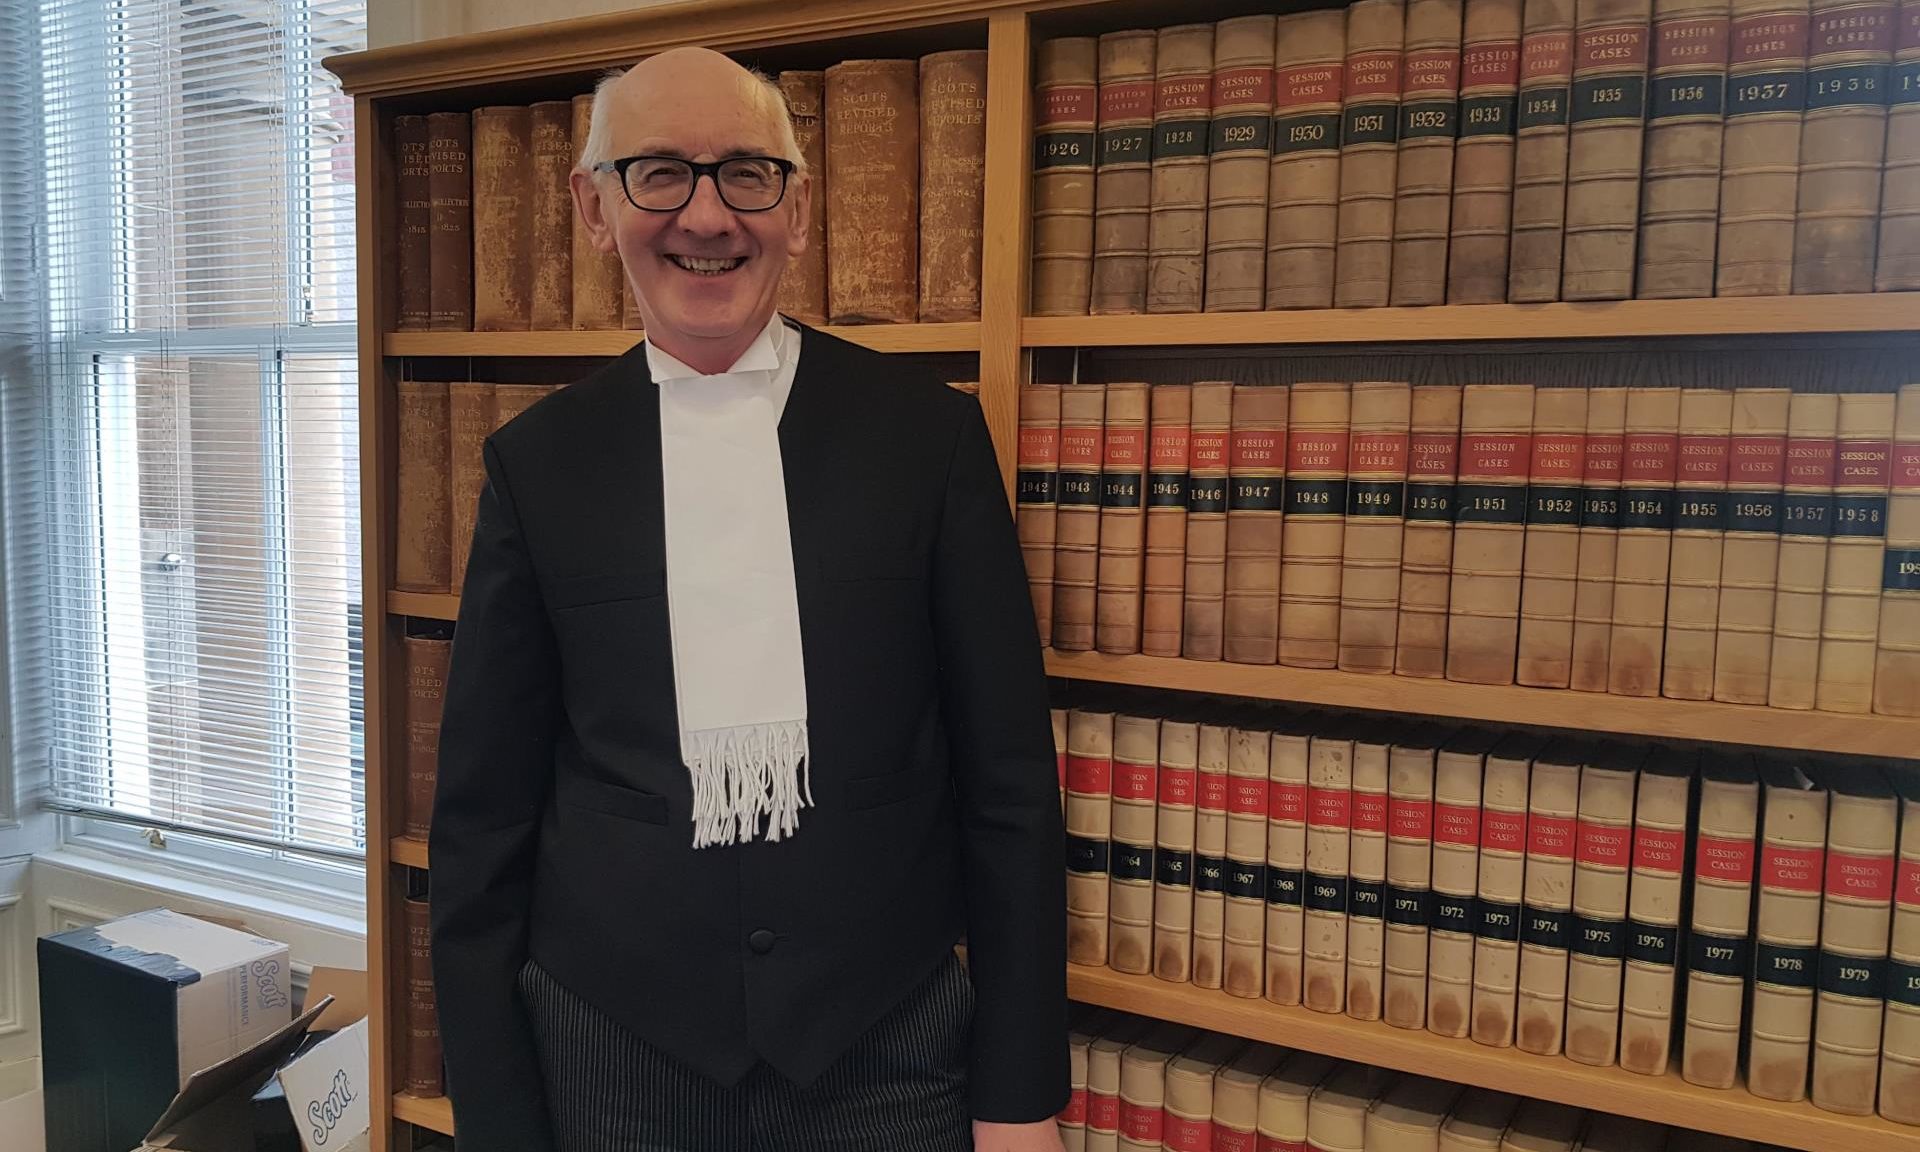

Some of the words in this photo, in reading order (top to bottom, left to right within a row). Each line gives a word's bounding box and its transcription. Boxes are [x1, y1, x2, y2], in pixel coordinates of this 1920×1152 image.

[1584, 33, 1640, 48] SESSION
[1590, 46, 1632, 60] CASES
[1745, 40, 1786, 55] CASES
[1462, 50, 1519, 66] SESSION
[1351, 60, 1394, 73] SESSION
[1408, 59, 1452, 72] SESSION
[1471, 62, 1508, 75] CASES
[1220, 75, 1263, 88] SESSION
[1288, 71, 1332, 85] SESSION
[1354, 73, 1387, 85] CASES
[1412, 73, 1446, 85] CASES
[1161, 83, 1206, 96] SESSION
[1291, 84, 1325, 97] CASES
[1738, 83, 1790, 101] 1937
[1818, 77, 1875, 95] 1938
[1223, 88, 1254, 100] CASES
[1592, 87, 1622, 103] 1935
[1671, 86, 1704, 101] 1936
[1165, 95, 1199, 107] CASES
[1527, 99, 1559, 114] 1934
[1049, 106, 1077, 114] ASES
[1468, 107, 1501, 123] 1933
[1352, 116, 1385, 132] 1931
[1409, 112, 1447, 128] 1932
[1164, 131, 1193, 144] 1928
[1224, 126, 1256, 142] 1929
[1288, 125, 1325, 142] 1930
[1042, 142, 1080, 156] 1926
[1105, 137, 1143, 152] 1927
[1237, 438, 1275, 449] SESSION
[1297, 442, 1338, 453] SESSION
[1411, 443, 1453, 455] SESSION
[1473, 442, 1516, 452] SESSION
[1537, 443, 1577, 454] SESSION
[1629, 442, 1671, 453] SESSION
[1682, 444, 1725, 456] SESSION
[1737, 444, 1781, 456] SESSION
[1111, 449, 1132, 459] CASES
[1197, 450, 1220, 460] CASES
[1242, 450, 1270, 460] CASES
[1787, 447, 1833, 459] SESSION
[1840, 451, 1885, 462] SESSION
[1301, 456, 1331, 466] CASES
[1415, 459, 1446, 470] CASES
[1477, 458, 1510, 468] CASES
[1540, 458, 1570, 469] CASES
[1588, 459, 1618, 470] CASES
[1632, 458, 1664, 469] CASES
[1685, 461, 1718, 472] CASES
[1741, 461, 1774, 472] CASES
[1843, 466, 1879, 476] CASES
[1022, 482, 1049, 494] 1942
[1065, 481, 1091, 493] 1943
[1106, 483, 1135, 496] 1944
[1153, 483, 1179, 495] 1945
[1238, 486, 1270, 498] 1947
[1191, 488, 1222, 501] 1946
[1296, 492, 1329, 504] 1948
[1356, 492, 1391, 505] 1949
[1413, 497, 1447, 510] 1950
[1474, 497, 1506, 511] 1951
[1538, 499, 1574, 513] 1952
[1584, 500, 1617, 513] 1953
[1629, 501, 1662, 515] 1954
[1681, 502, 1718, 516] 1955
[1735, 503, 1772, 517] 1956
[1786, 506, 1825, 521] 1957
[1838, 508, 1879, 523] 1958
[1899, 562, 1920, 575] 195
[1396, 808, 1426, 819] ESSION
[1489, 831, 1517, 843] CASES
[1536, 836, 1564, 848] CASES
[1639, 836, 1677, 850] SESSION
[1588, 845, 1617, 858] CASES
[1642, 849, 1672, 862] CASES
[1706, 847, 1747, 860] SESSION
[1164, 860, 1183, 872] 965
[1711, 859, 1742, 872] CASES
[1774, 856, 1814, 869] SESSION
[1200, 867, 1220, 878] 966
[1233, 872, 1255, 885] 1967
[1778, 868, 1809, 880] CASES
[1273, 878, 1295, 891] 1968
[1845, 877, 1878, 889] CASES
[1313, 885, 1337, 898] 1969
[1354, 890, 1378, 904] 1970
[1395, 898, 1419, 912] 1971
[1440, 905, 1465, 919] 1972
[1485, 911, 1511, 927] 1973
[1531, 918, 1559, 934] 1974
[1584, 928, 1612, 944] 1975
[1637, 933, 1665, 949] 1976
[1705, 945, 1734, 961] 1977
[1773, 956, 1803, 971] 1978
[1839, 967, 1870, 981] 1979
[251, 959, 287, 1009] Scott
[308, 1069, 352, 1146] Scott
